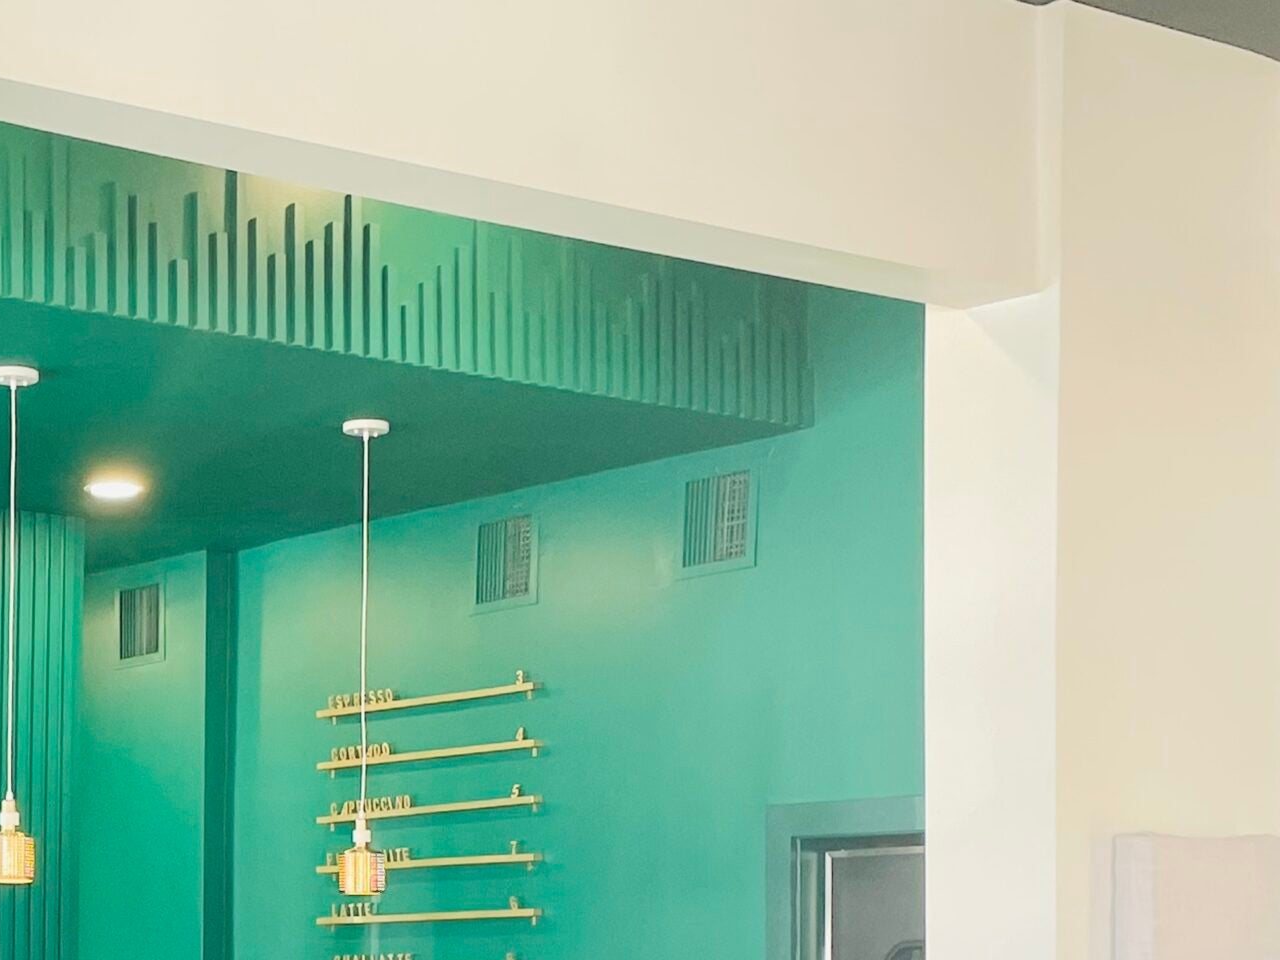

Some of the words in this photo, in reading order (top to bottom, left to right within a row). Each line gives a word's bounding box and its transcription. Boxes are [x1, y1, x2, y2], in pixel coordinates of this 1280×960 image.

[328, 688, 393, 709] ESPRSSO
[515, 670, 524, 684] 3
[515, 727, 525, 740] 4
[510, 784, 521, 798] 5
[331, 902, 372, 918] LATTE
